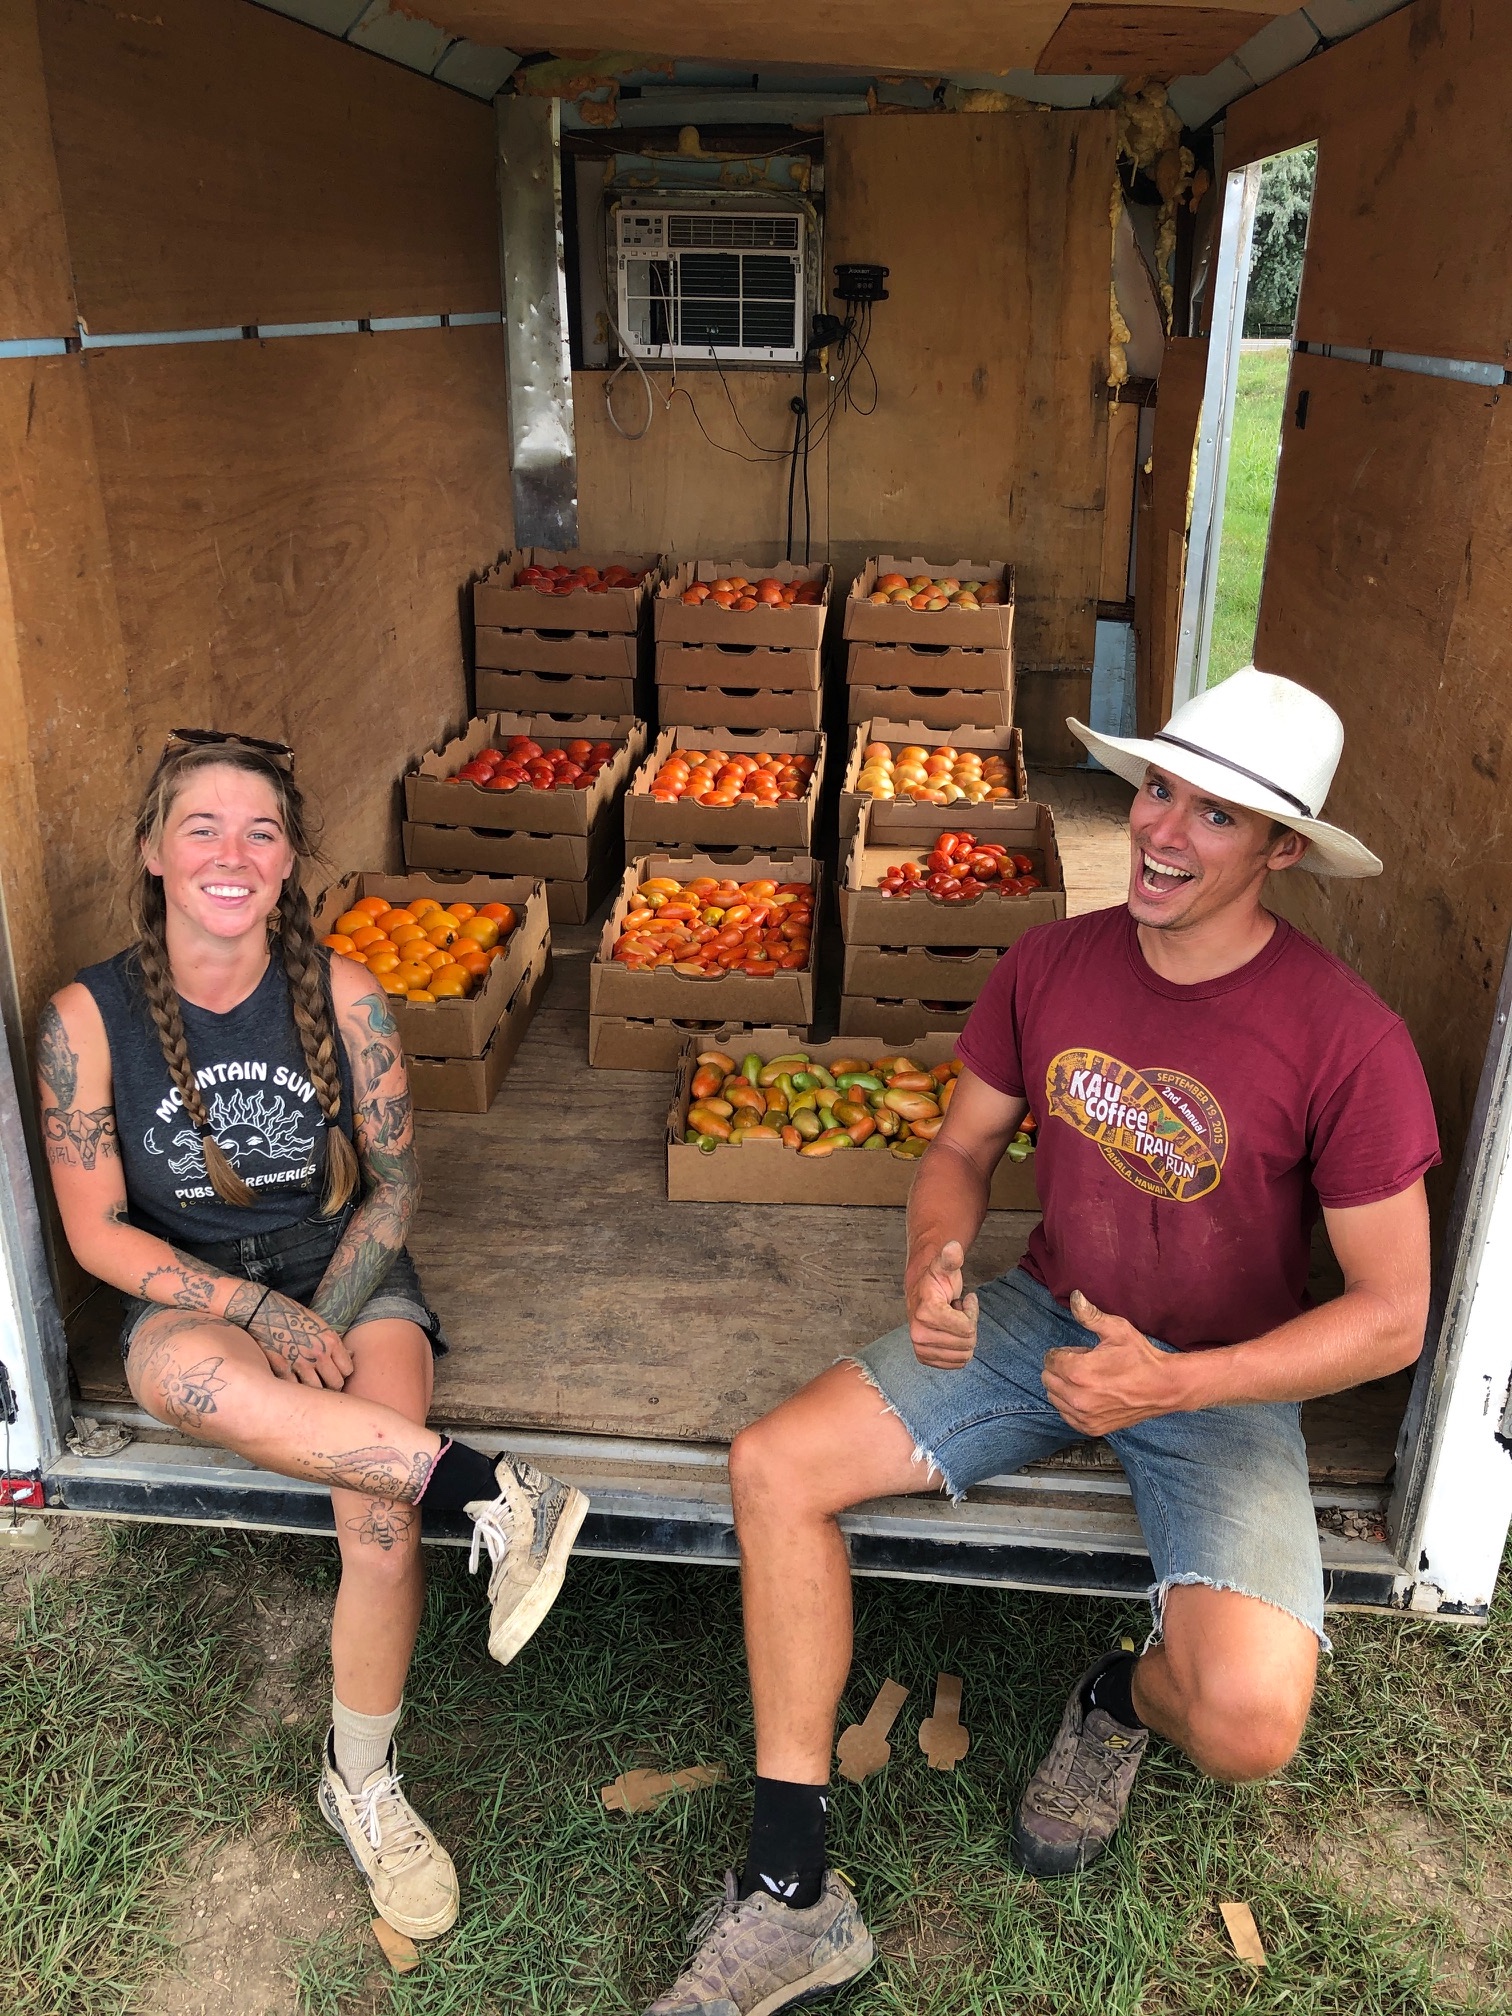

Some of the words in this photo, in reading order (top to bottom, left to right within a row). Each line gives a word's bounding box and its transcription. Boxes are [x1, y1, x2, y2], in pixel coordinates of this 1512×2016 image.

[155, 1061, 267, 1123] MONTAIN
[273, 1066, 317, 1104] SUN
[1157, 1072, 1209, 1104] SEPTEMBER
[1206, 1104, 1217, 1120] 19,
[1212, 1120, 1223, 1144] 2015
[1161, 1086, 1182, 1105] 2nd
[1177, 1103, 1207, 1135] Annual
[1135, 1131, 1182, 1160] TRAIL
[174, 1186, 215, 1199] PUBS
[240, 1164, 317, 1188] REWERIES
[1165, 1156, 1195, 1178] RUN
